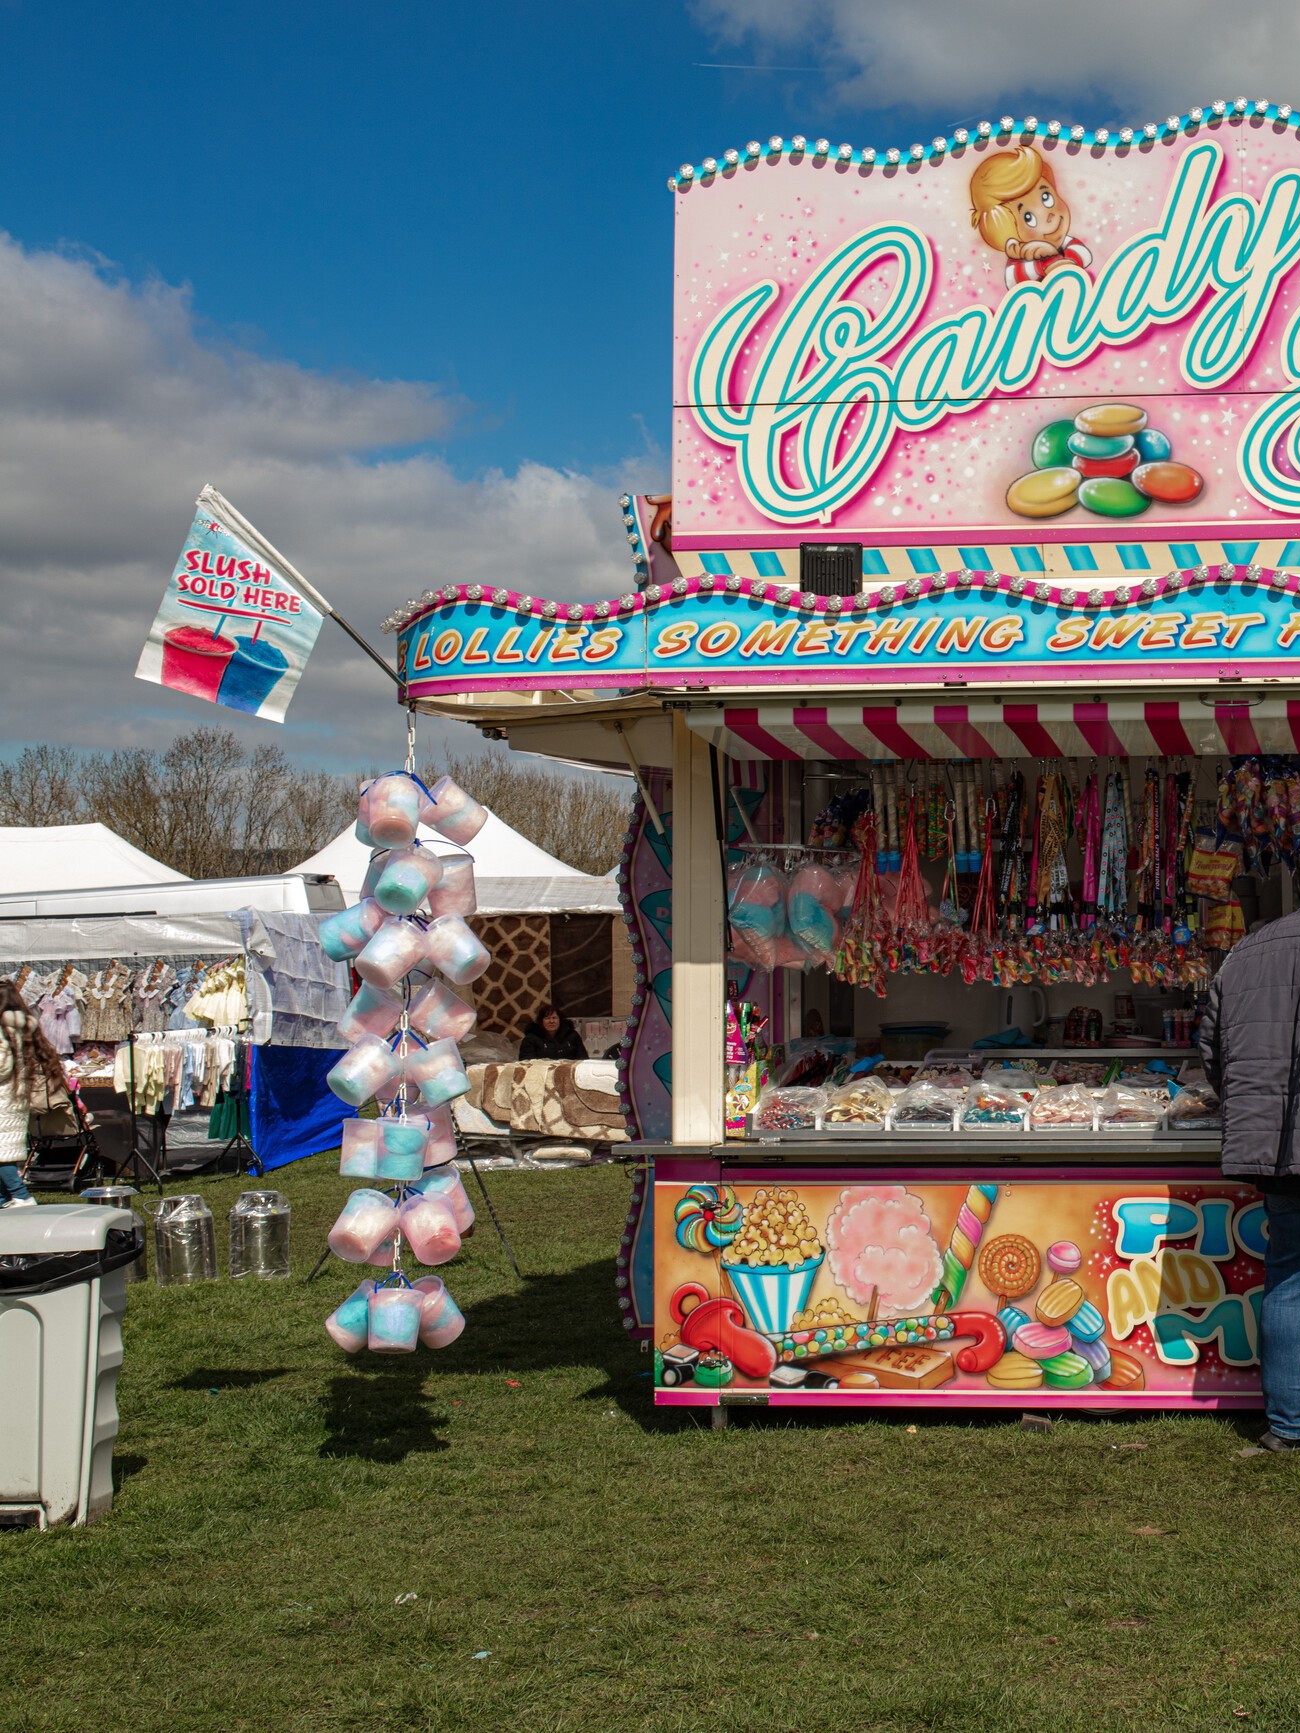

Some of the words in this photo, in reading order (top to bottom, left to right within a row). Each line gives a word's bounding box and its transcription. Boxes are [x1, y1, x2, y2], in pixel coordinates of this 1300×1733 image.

[185, 549, 271, 586] SLUSH
[177, 574, 236, 600] SOLD
[243, 586, 302, 613] HERE
[413, 627, 623, 671] LOLLIES
[653, 611, 1024, 658] SOMETHING
[1046, 610, 1264, 652] SWEET
[1106, 1247, 1225, 1341] AND
